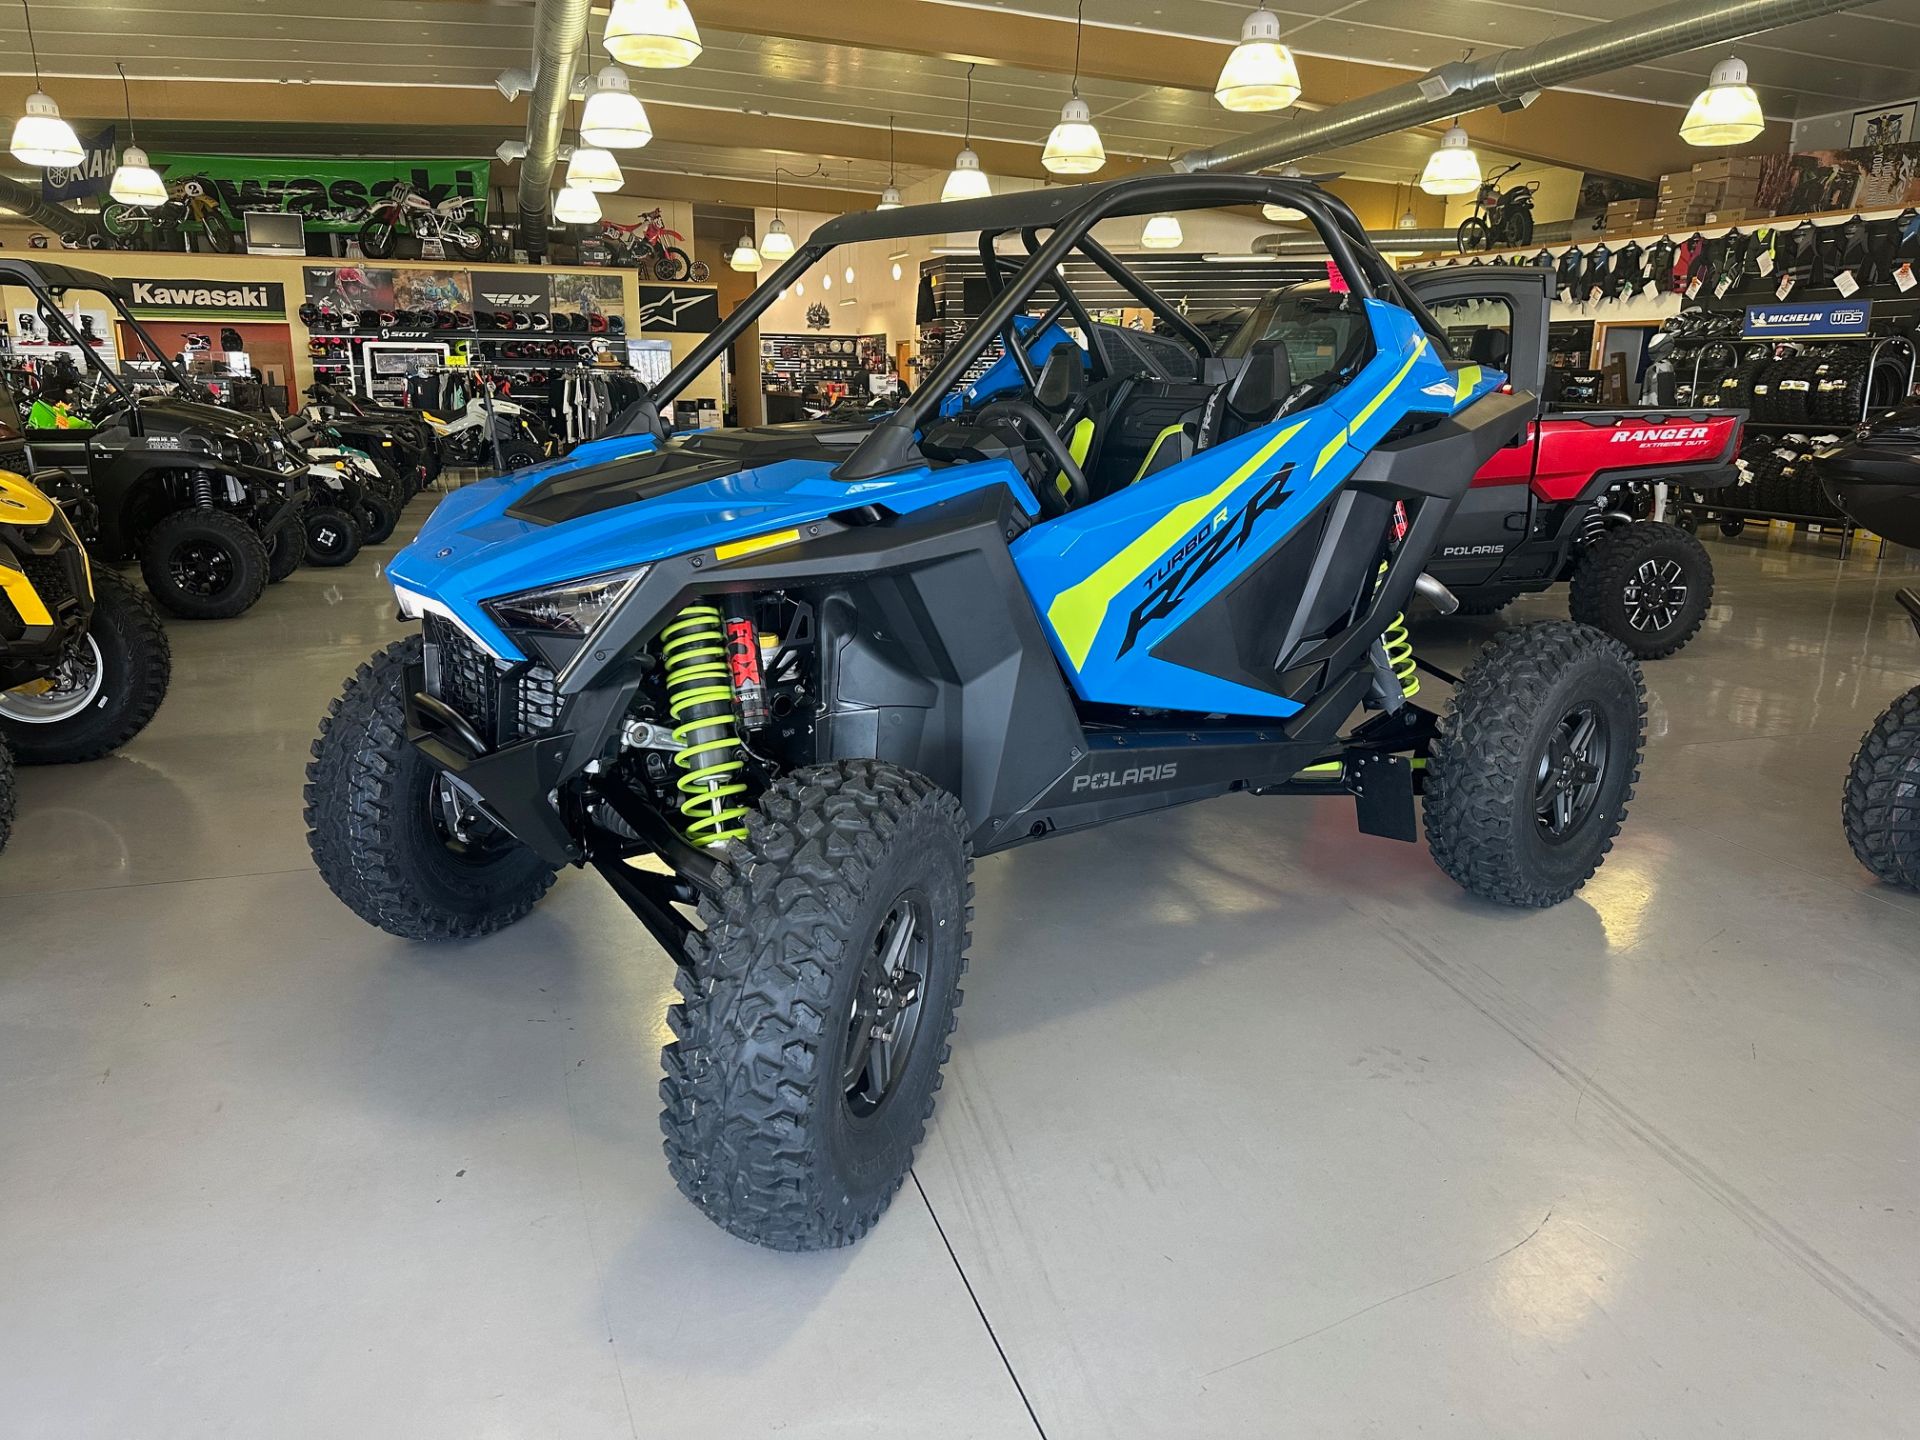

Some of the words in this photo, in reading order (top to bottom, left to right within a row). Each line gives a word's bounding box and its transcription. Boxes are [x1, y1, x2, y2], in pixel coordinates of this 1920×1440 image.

[132, 283, 268, 307] Kawasaki
[481, 293, 541, 305] FLY
[1768, 313, 1823, 323] MICHELIN
[1830, 311, 1864, 325] WPS
[1610, 427, 1709, 443] RANGER
[1639, 441, 1684, 449] EXTREME
[1143, 523, 1211, 591] TURBO
[1213, 506, 1229, 533] R
[1443, 544, 1505, 556] POLARIS
[1114, 462, 1296, 662] RZR
[726, 619, 761, 689] FOX
[739, 692, 760, 702] VALVE
[1072, 762, 1178, 793] POLARIS
